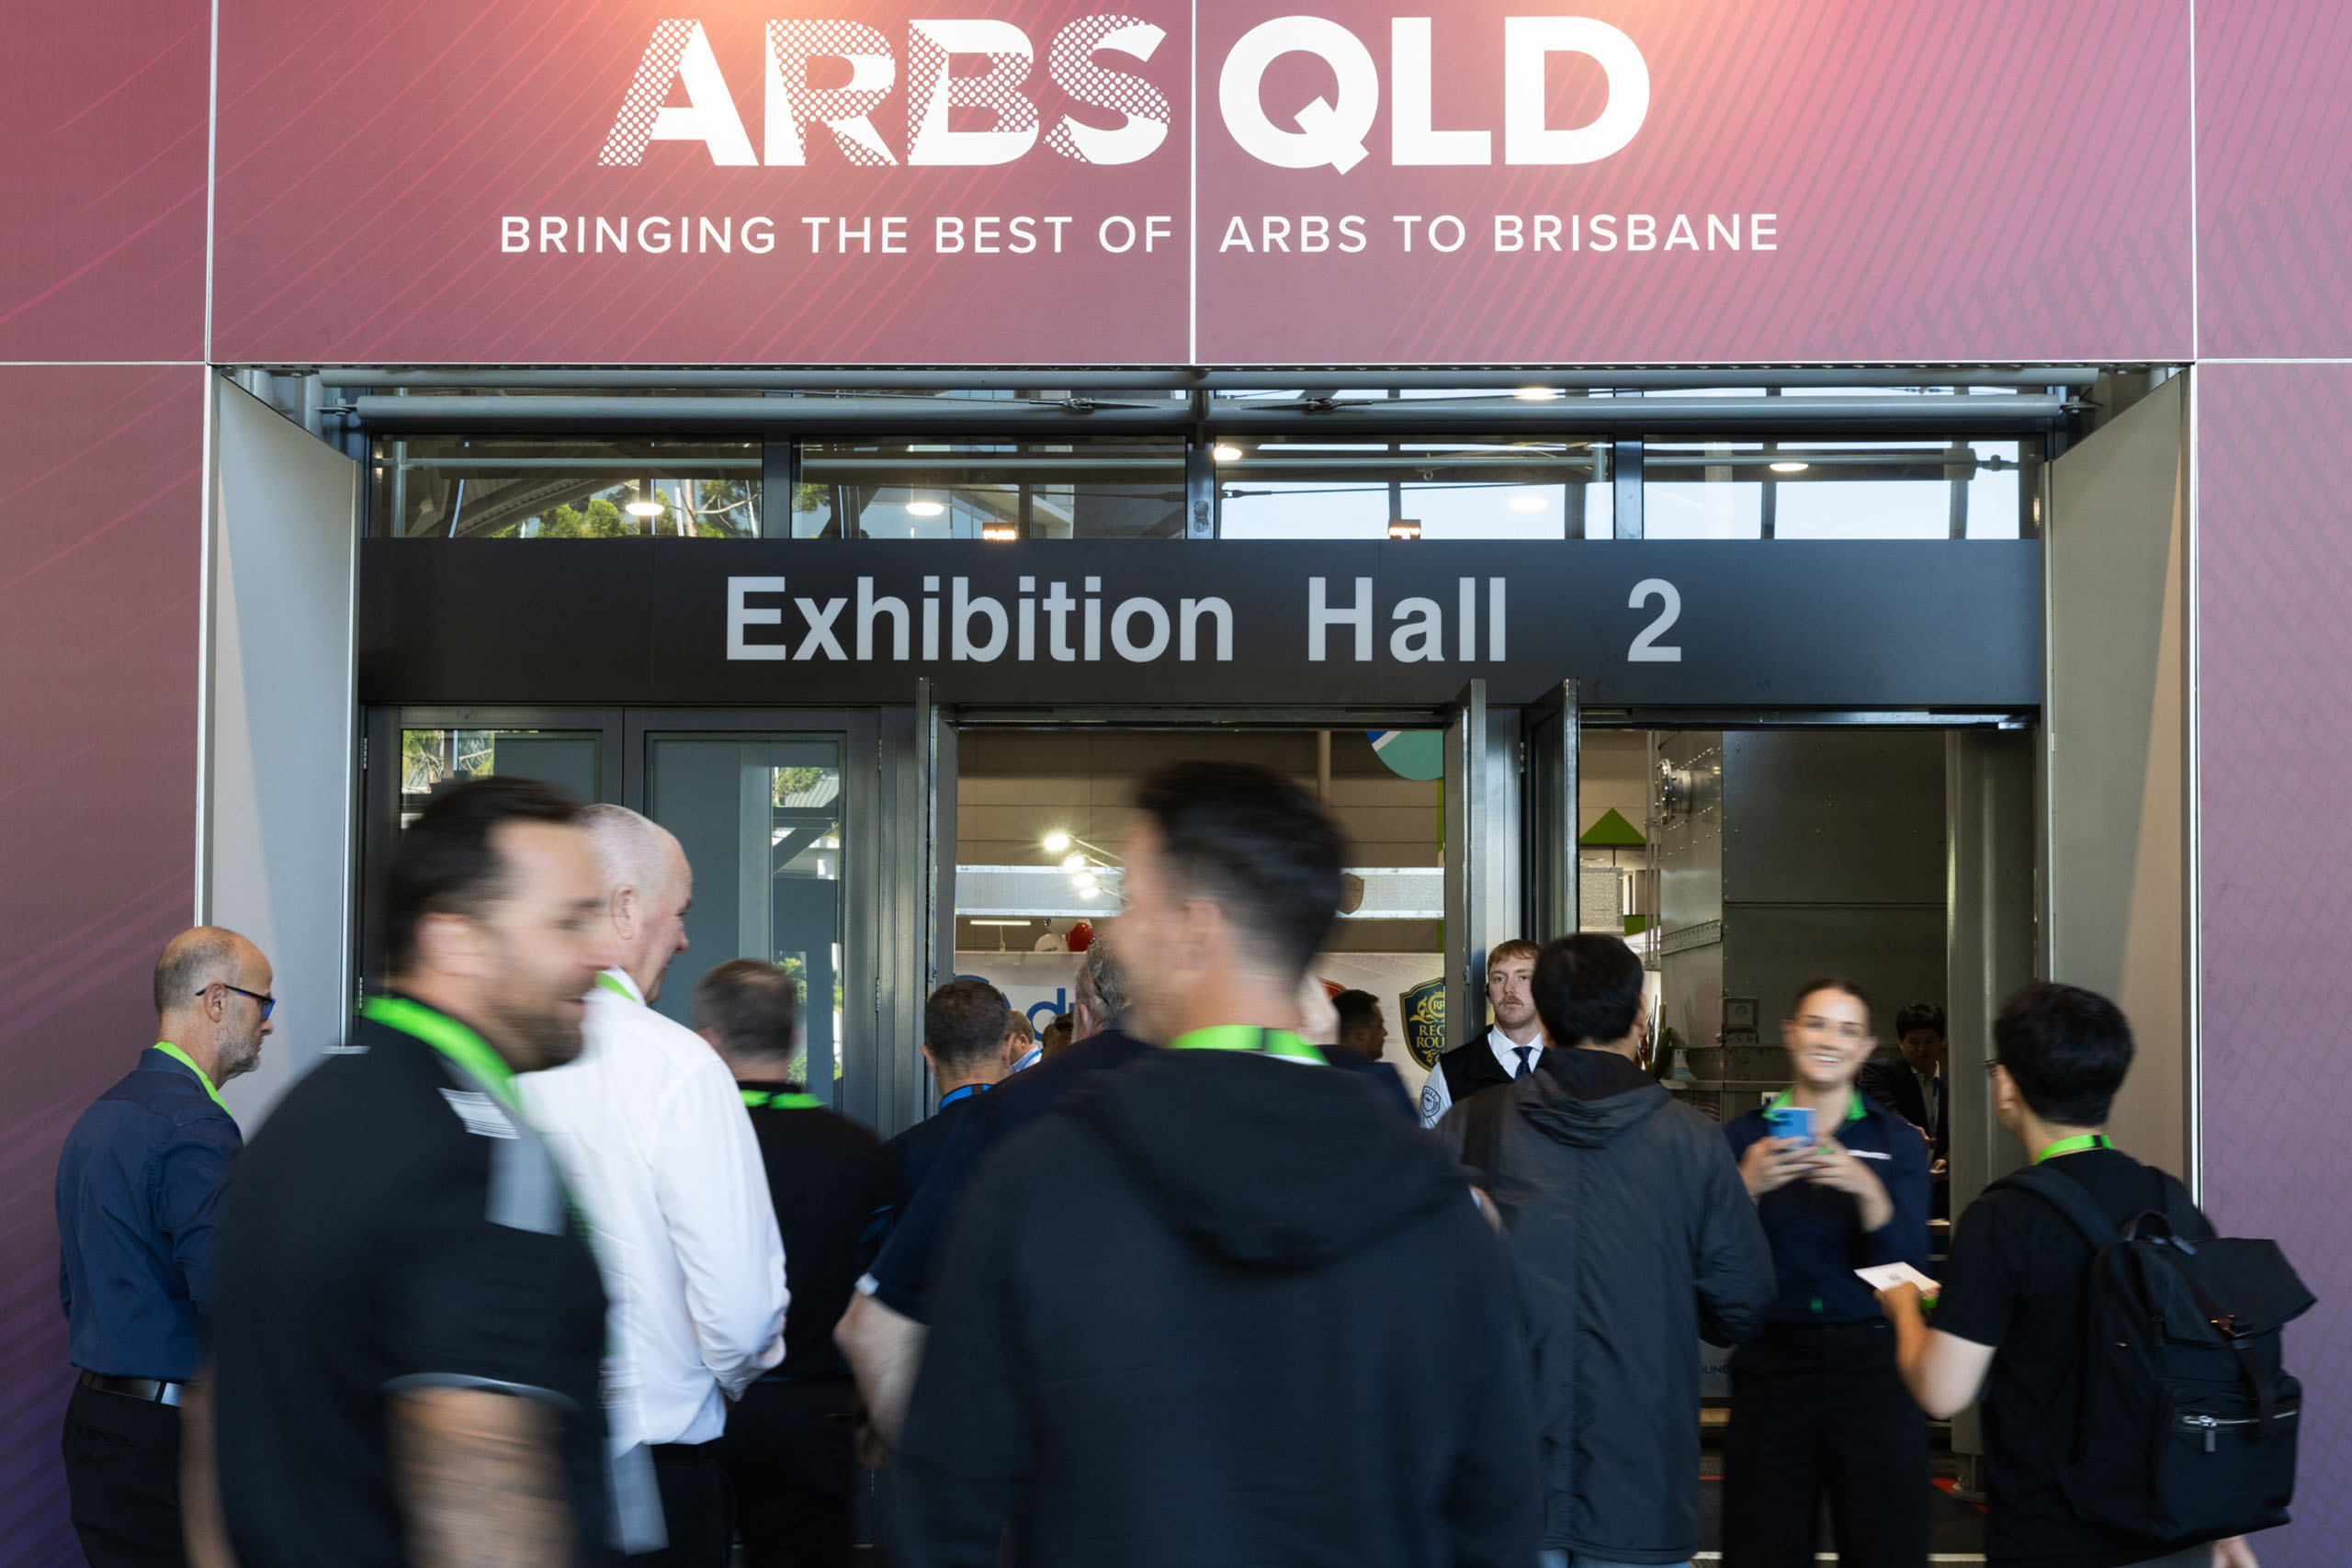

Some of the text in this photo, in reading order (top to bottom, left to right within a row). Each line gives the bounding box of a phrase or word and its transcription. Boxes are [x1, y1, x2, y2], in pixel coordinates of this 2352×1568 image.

[598, 14, 1650, 175] ARBS QLD
[501, 213, 1778, 254] BRINGING THE BEST OF ARBS TO BRISBANE
[727, 576, 1682, 662] Exhibition Hall 2
